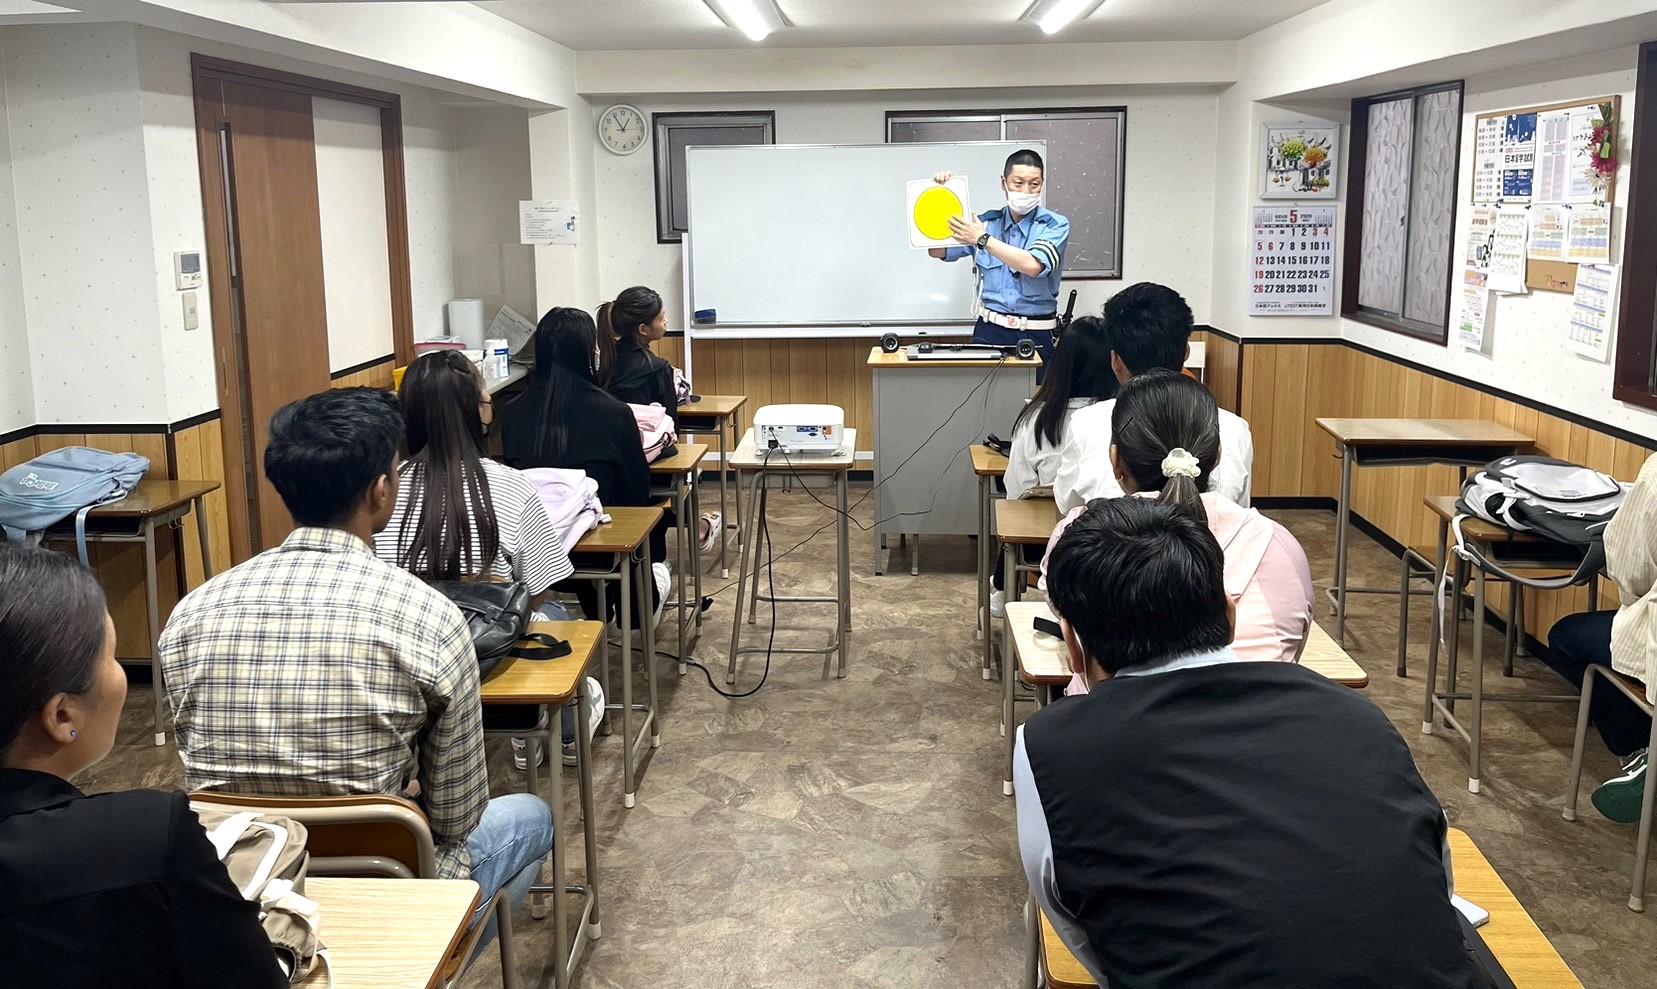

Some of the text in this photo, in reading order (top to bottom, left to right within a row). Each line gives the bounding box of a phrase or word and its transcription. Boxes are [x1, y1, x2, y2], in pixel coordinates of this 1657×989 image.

[1290, 210, 1298, 223] 5
[1292, 228, 1295, 236] 1
[1301, 228, 1306, 236] 2
[1313, 228, 1318, 236] 3
[1323, 228, 1328, 236] 4
[1258, 242, 1330, 250] 5 6 7 8 9 10 11
[1255, 256, 1330, 264] 12 13 14 15 16 17 18
[1255, 270, 1330, 279] 19 20 21 22 23 24 25
[1254, 284, 1263, 293] 26
[1265, 284, 1274, 293] 27
[1276, 284, 1285, 293] 28
[1286, 284, 1296, 293] 29
[1297, 284, 1307, 293] 30
[1308, 284, 1317, 293] 31
